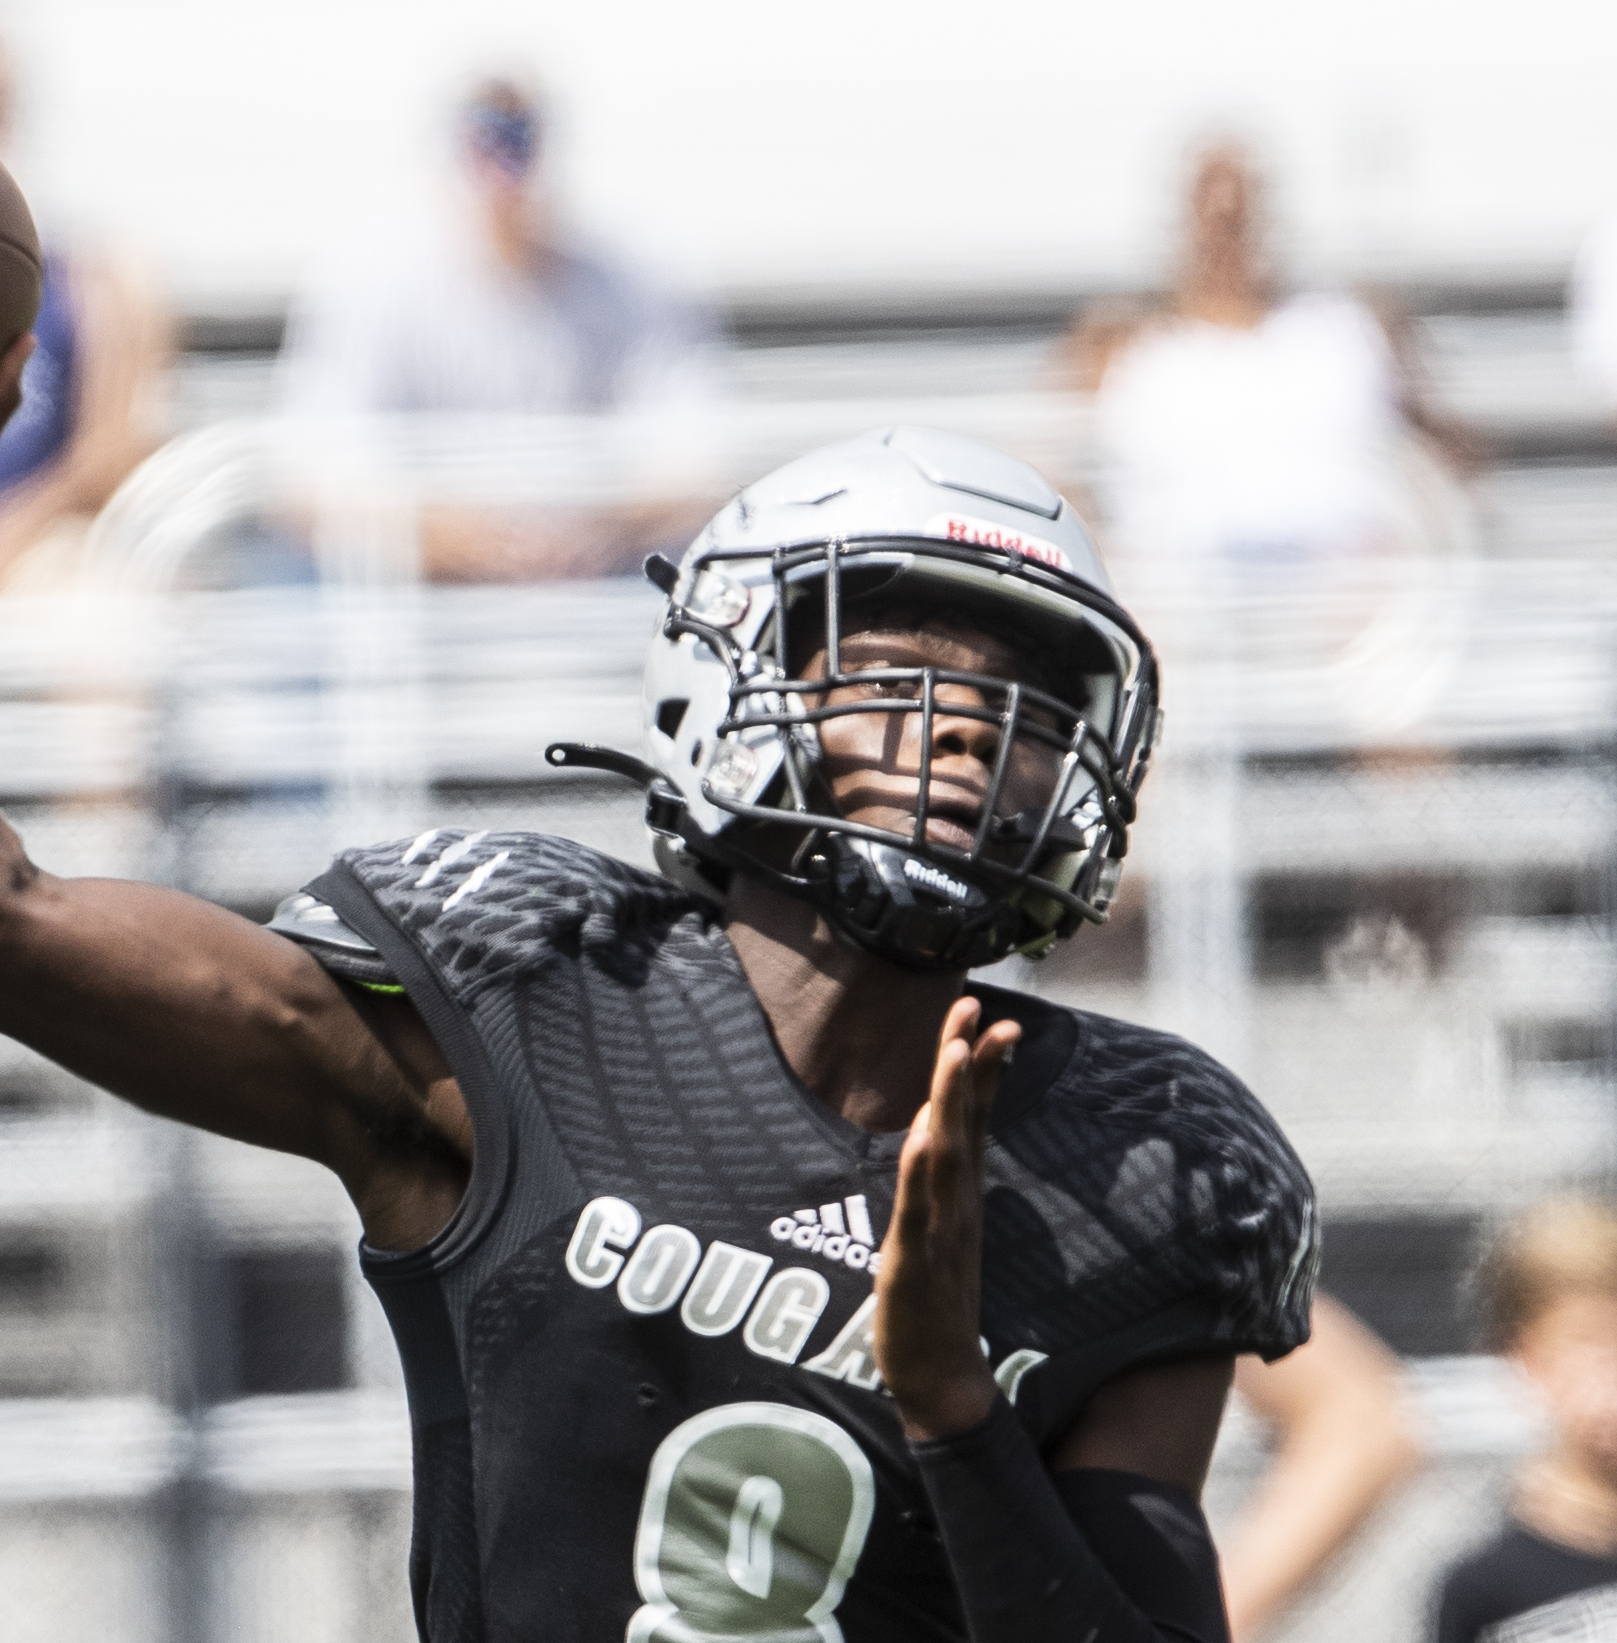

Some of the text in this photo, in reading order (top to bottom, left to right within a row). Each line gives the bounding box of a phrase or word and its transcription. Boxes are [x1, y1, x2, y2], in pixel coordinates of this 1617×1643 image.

[904, 858, 968, 899] Riddell
[770, 1217, 882, 1275] adidas
[566, 1197, 1049, 1406] COUGA
